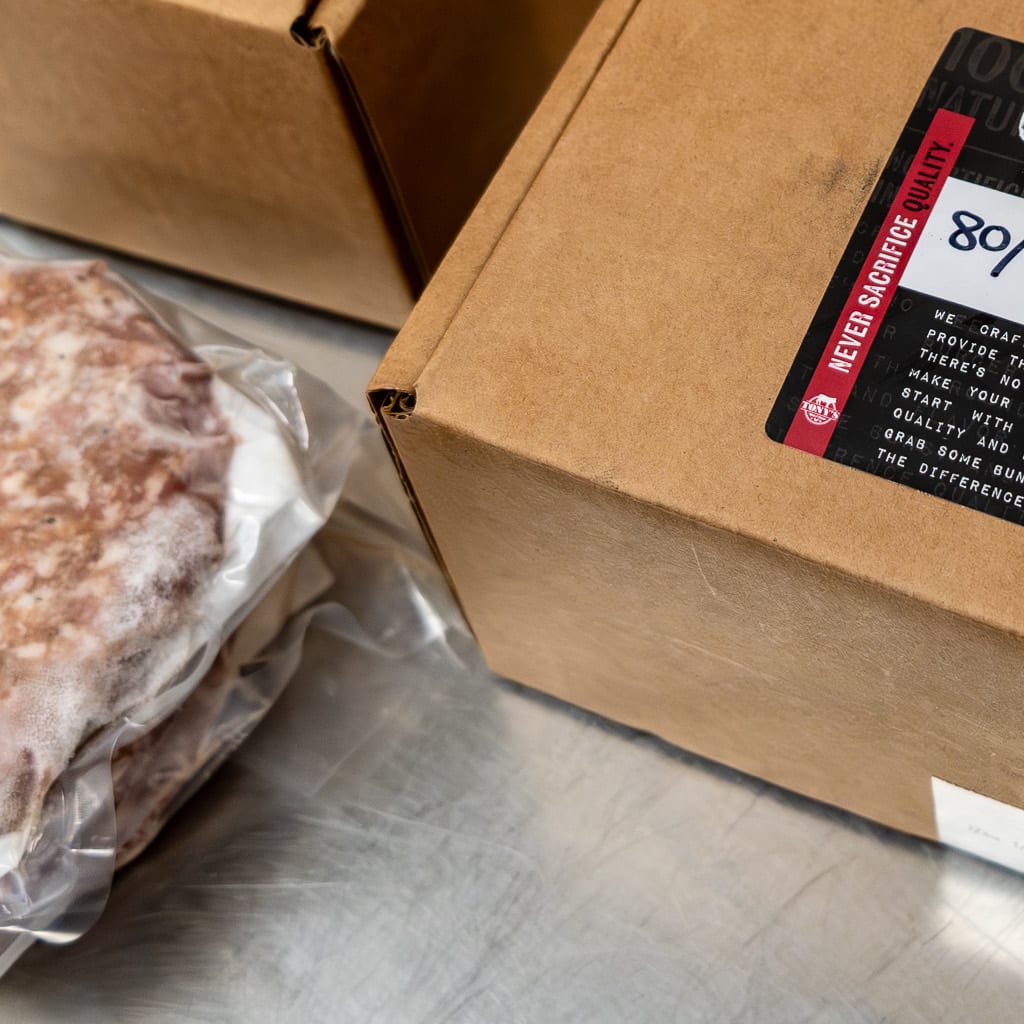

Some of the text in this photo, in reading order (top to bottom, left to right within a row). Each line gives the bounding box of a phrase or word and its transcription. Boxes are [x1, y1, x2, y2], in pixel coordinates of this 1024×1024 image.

[827, 140, 955, 374] NEVER SACRIFICE QUALITY.
[934, 309, 956, 325] WE
[926, 328, 999, 361] PROVIDE
[908, 368, 952, 390] MAKE
[970, 385, 1011, 409] YOUR
[920, 347, 986, 378] THERE'S
[999, 374, 1021, 390] NO
[893, 407, 966, 439] QUALITY
[976, 436, 1009, 454] AND
[901, 387, 953, 411] START
[971, 409, 1014, 433] WITH
[884, 428, 926, 450] GRAB
[937, 445, 982, 470] SOME
[877, 447, 908, 468] THE
[918, 462, 1024, 508] DIFFERENCE
